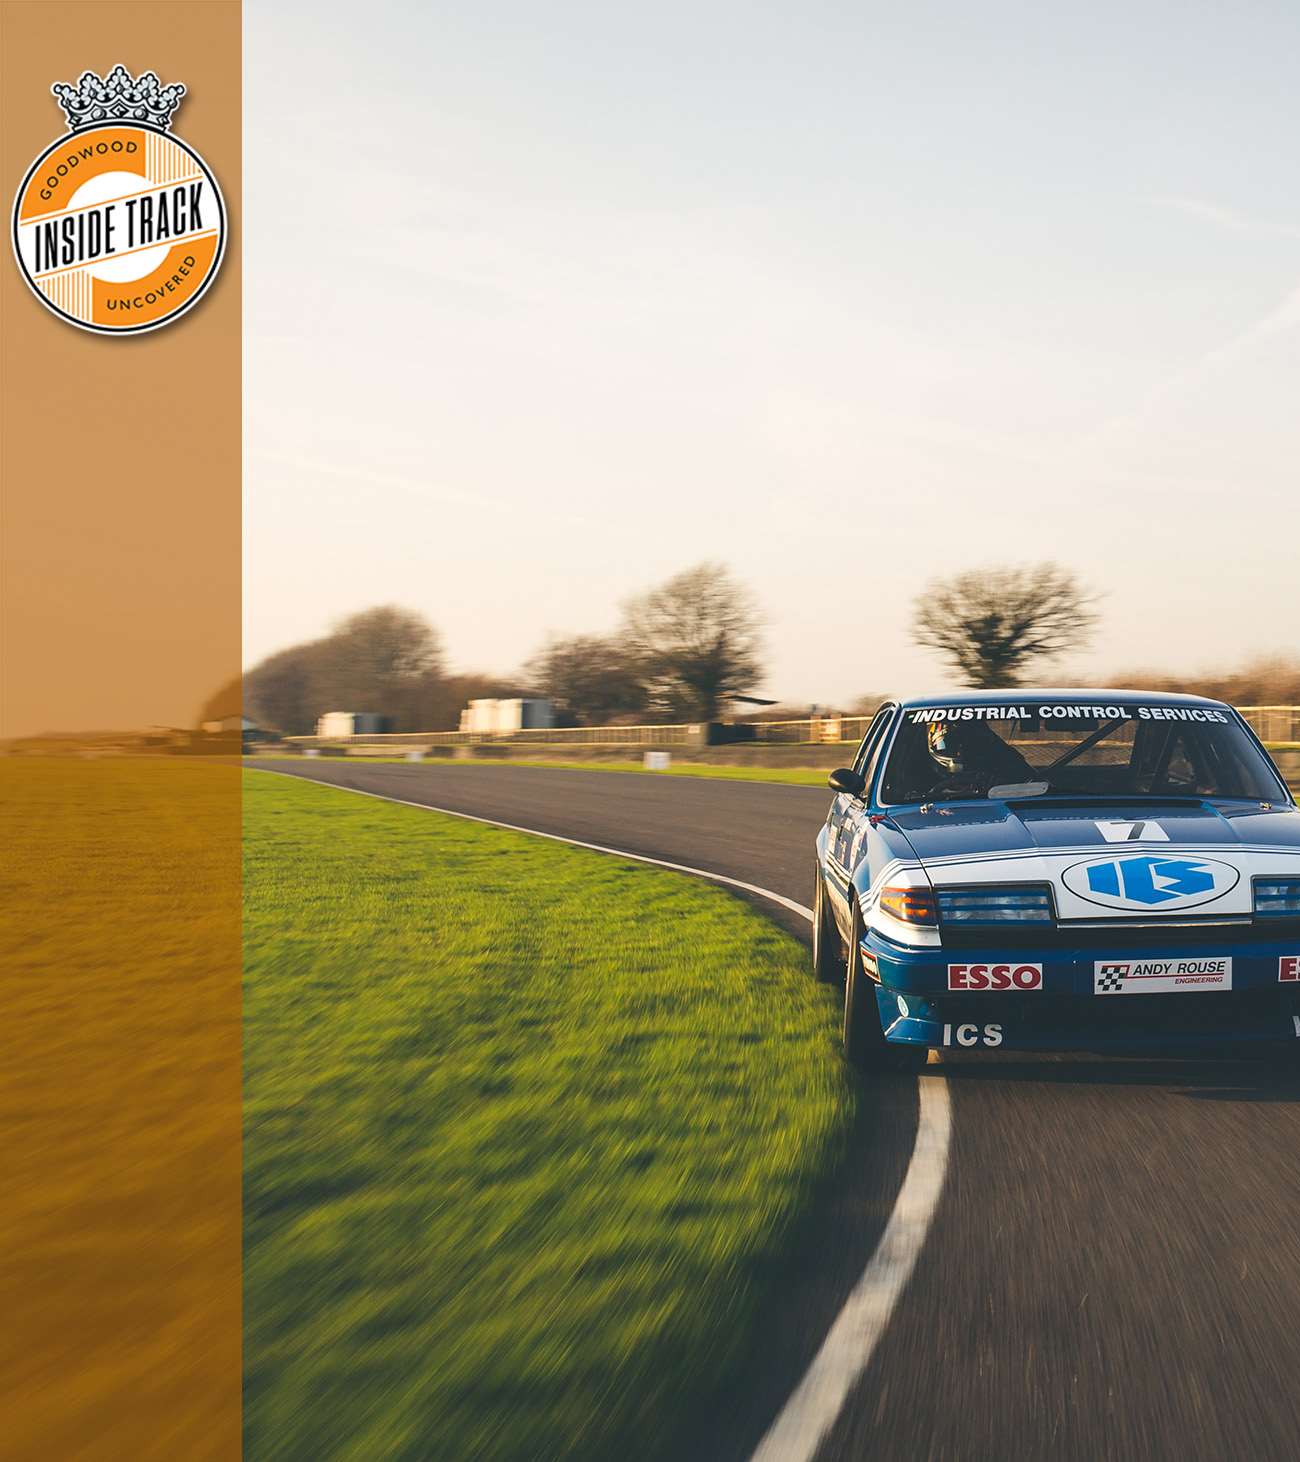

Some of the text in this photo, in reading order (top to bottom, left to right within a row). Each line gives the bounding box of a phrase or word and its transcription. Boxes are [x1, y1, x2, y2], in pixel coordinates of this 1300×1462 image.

[911, 706, 1230, 724] INDUSTRIAL CONTROL SERVICES
[1110, 821, 1146, 840] 7
[1133, 961, 1226, 975] ANDY ROUSE
[950, 966, 1042, 989] ESSO
[1174, 976, 1223, 985] ENGINEERING
[943, 1024, 1003, 1047] ICS
